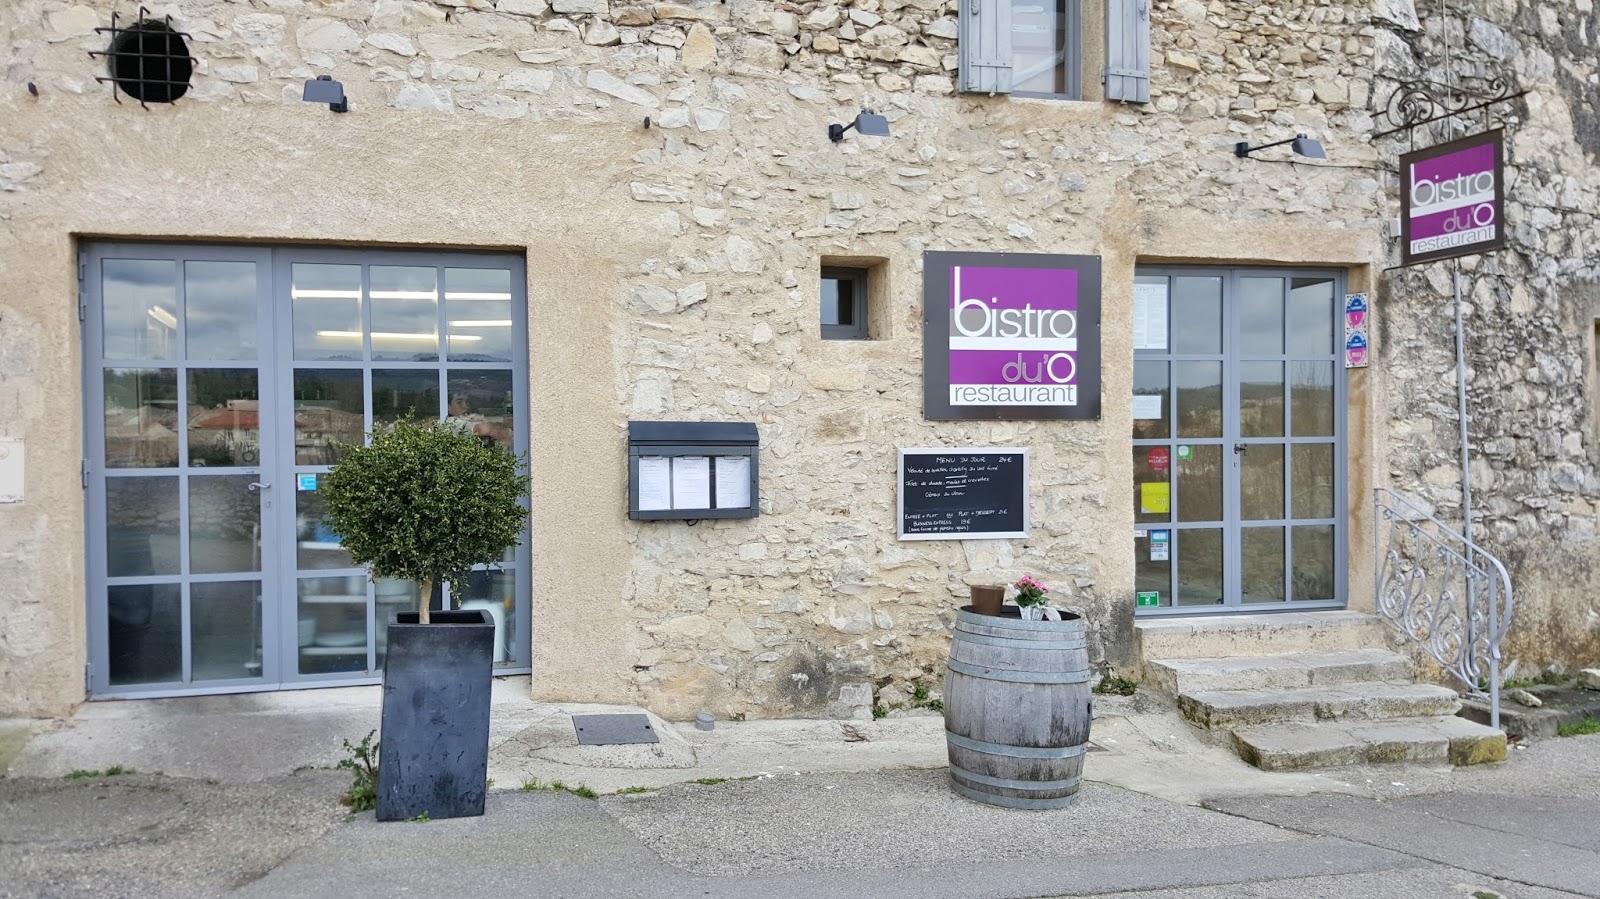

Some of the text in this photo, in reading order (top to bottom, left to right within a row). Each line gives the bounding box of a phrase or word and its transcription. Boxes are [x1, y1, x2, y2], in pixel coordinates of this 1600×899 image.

[1410, 163, 1494, 207] bistro
[1443, 203, 1494, 232] du'O
[1412, 226, 1493, 253] restaurant
[954, 266, 1077, 338] bistro
[1002, 352, 1076, 383] du'O
[955, 384, 1074, 402] restaurant
